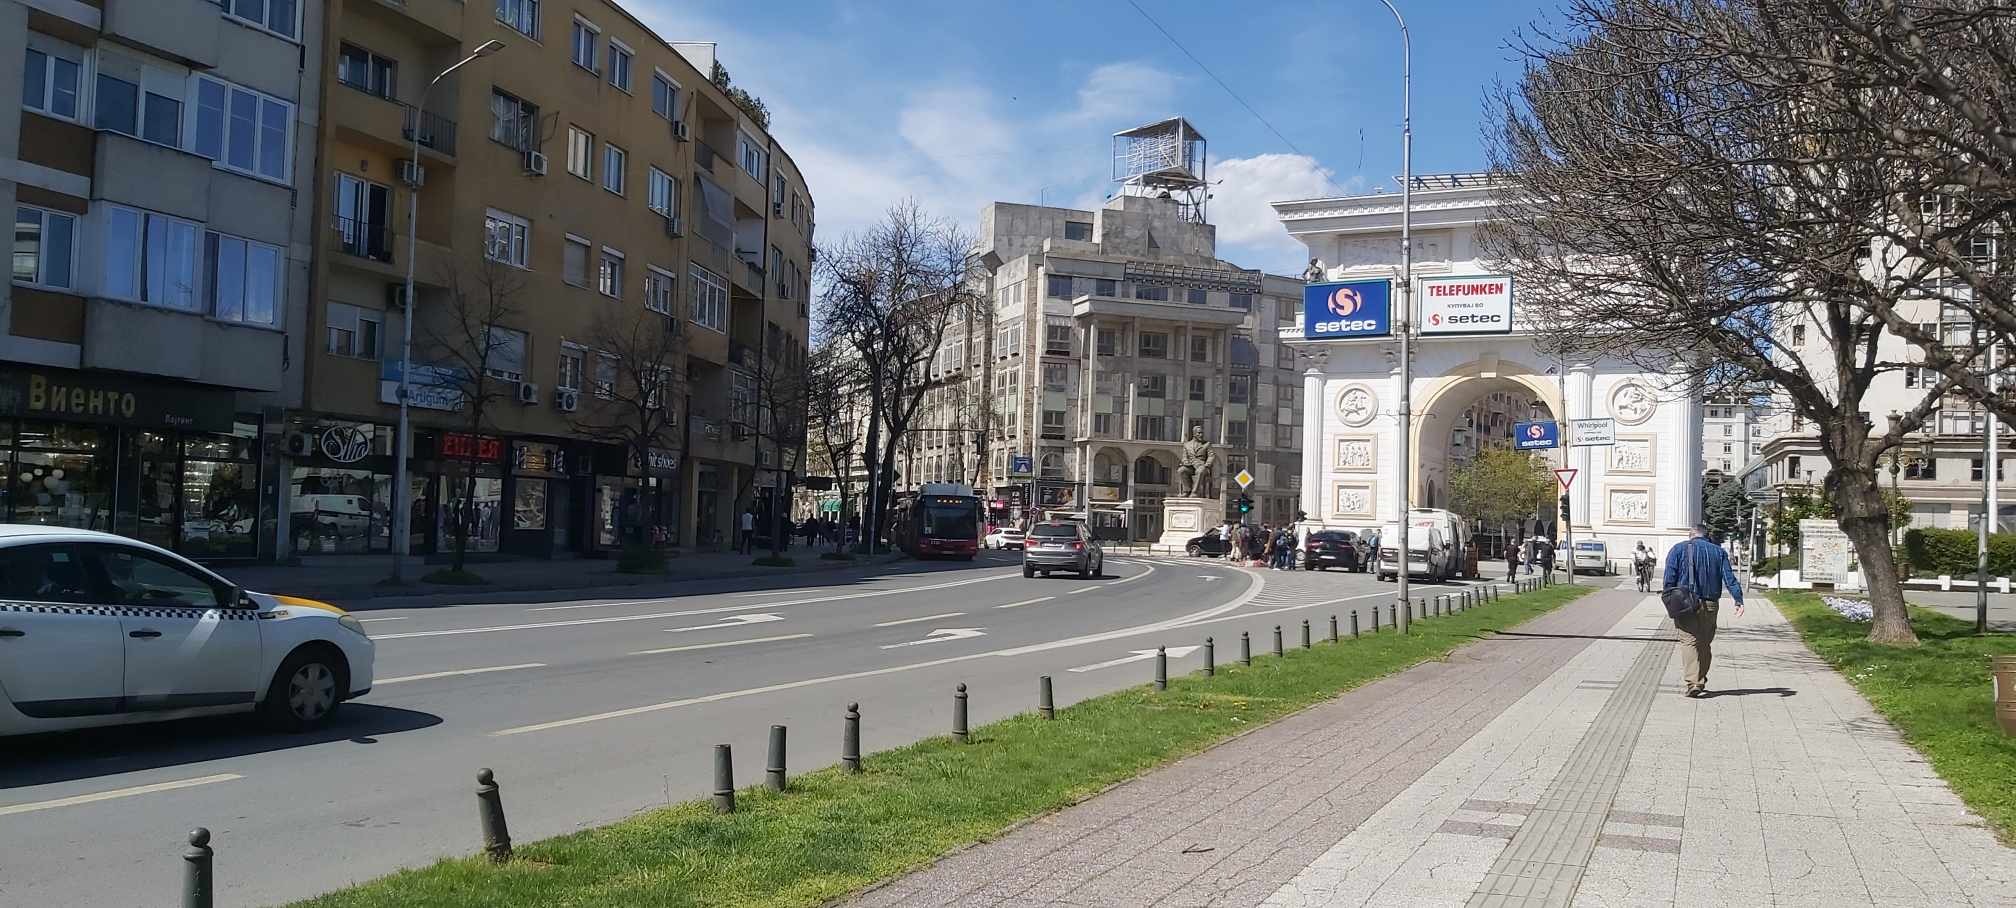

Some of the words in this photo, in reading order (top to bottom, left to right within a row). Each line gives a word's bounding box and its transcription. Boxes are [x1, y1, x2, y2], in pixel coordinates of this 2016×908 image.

[1428, 283, 1504, 297] TELEFUNKEN
[1447, 314, 1502, 324] setec
[1315, 319, 1377, 333] setec
[29, 373, 137, 418] Виенто
[1577, 421, 1608, 430] Whirlpool
[1521, 439, 1552, 447] setec
